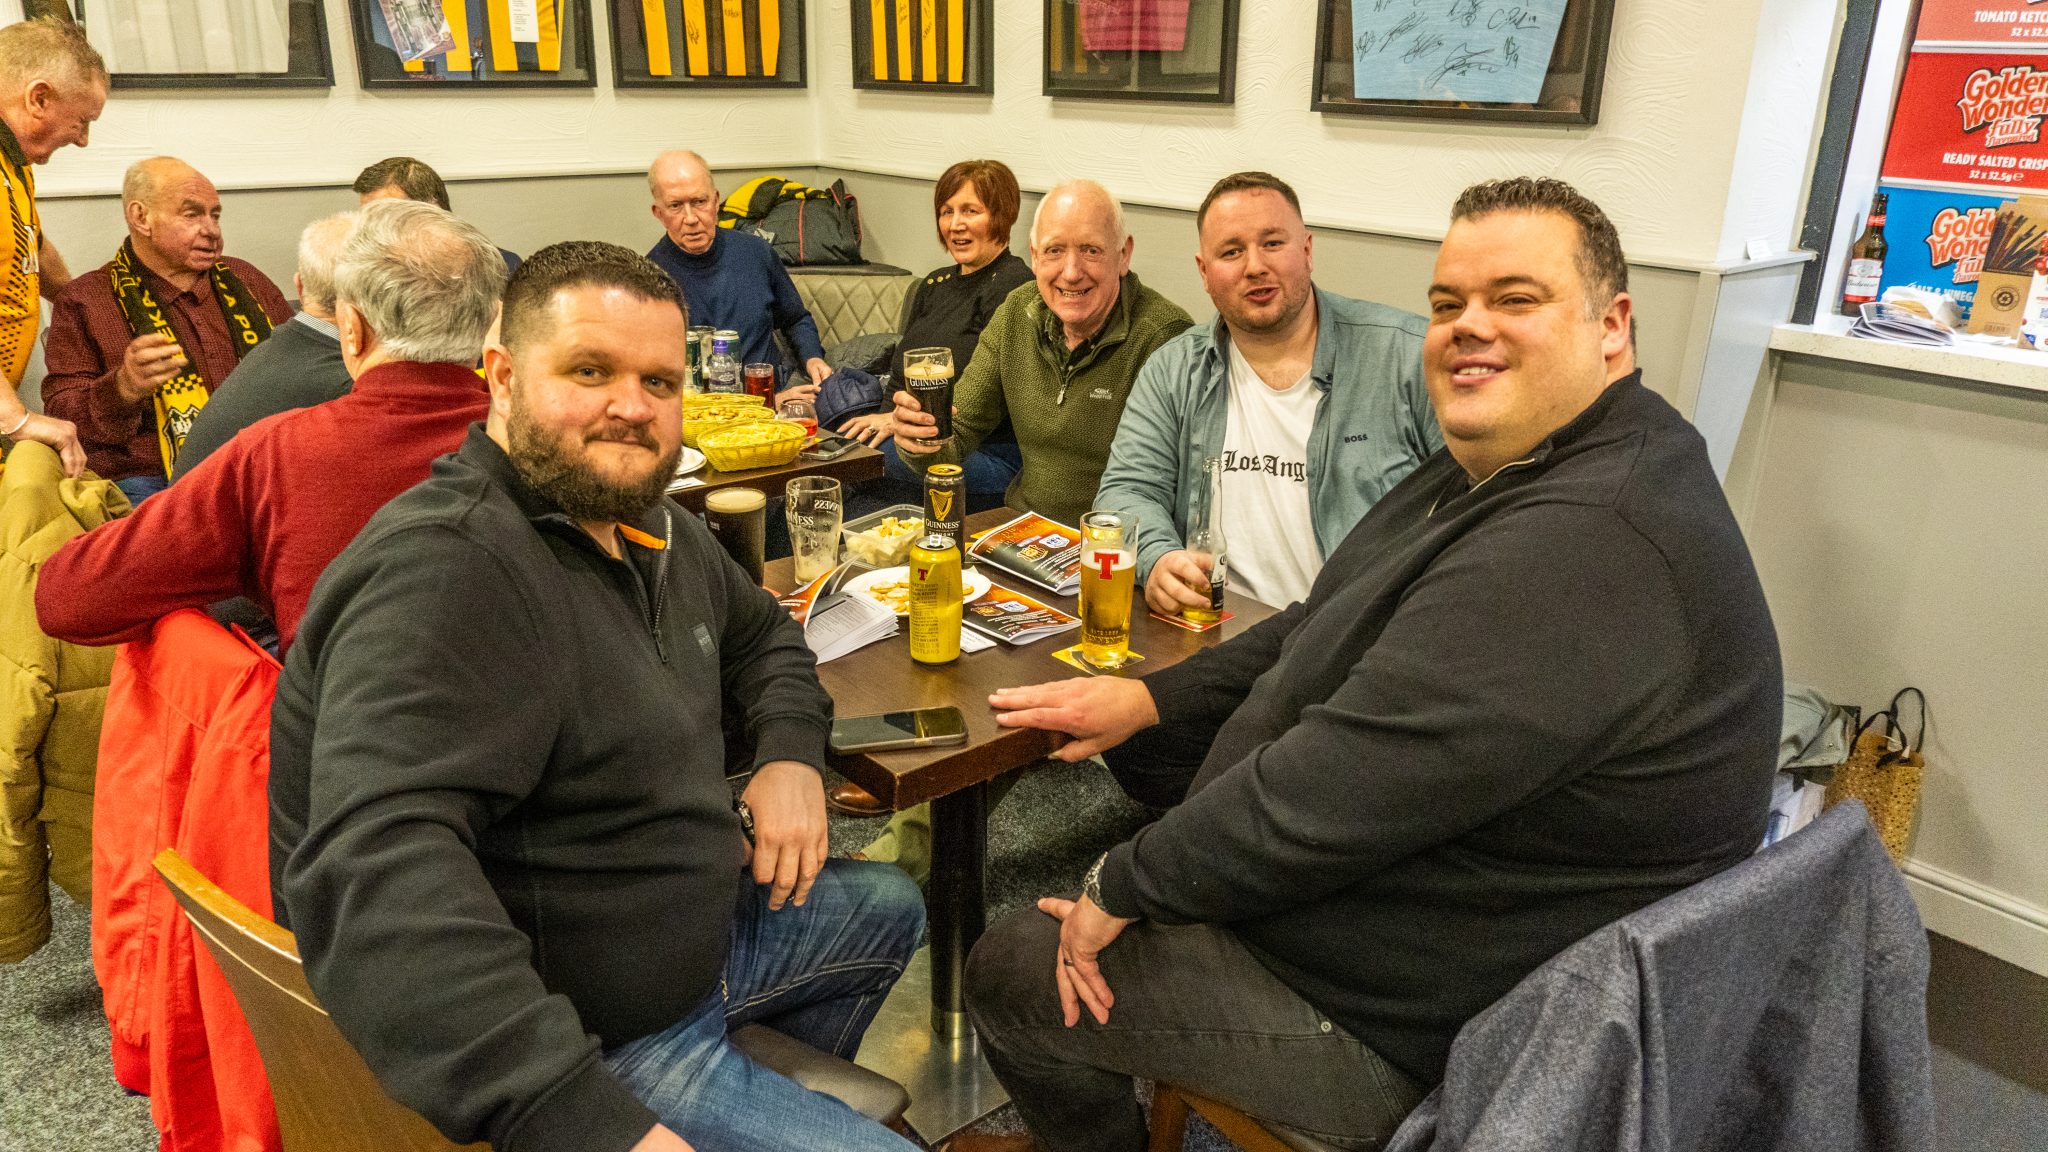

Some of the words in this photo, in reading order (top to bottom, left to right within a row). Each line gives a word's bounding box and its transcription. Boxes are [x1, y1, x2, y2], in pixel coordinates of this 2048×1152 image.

[1974, 10, 2018, 23] TOMATO
[1942, 152, 1978, 165] READY
[1978, 154, 2017, 168] SALTED
[1968, 169, 1979, 179] 32
[910, 377, 949, 387] GUINNESS
[1344, 433, 1368, 443] BOSS
[1262, 454, 1308, 482] Ang
[925, 518, 961, 529] GUINNESS
[1093, 551, 1120, 581] T
[917, 568, 929, 582] T
